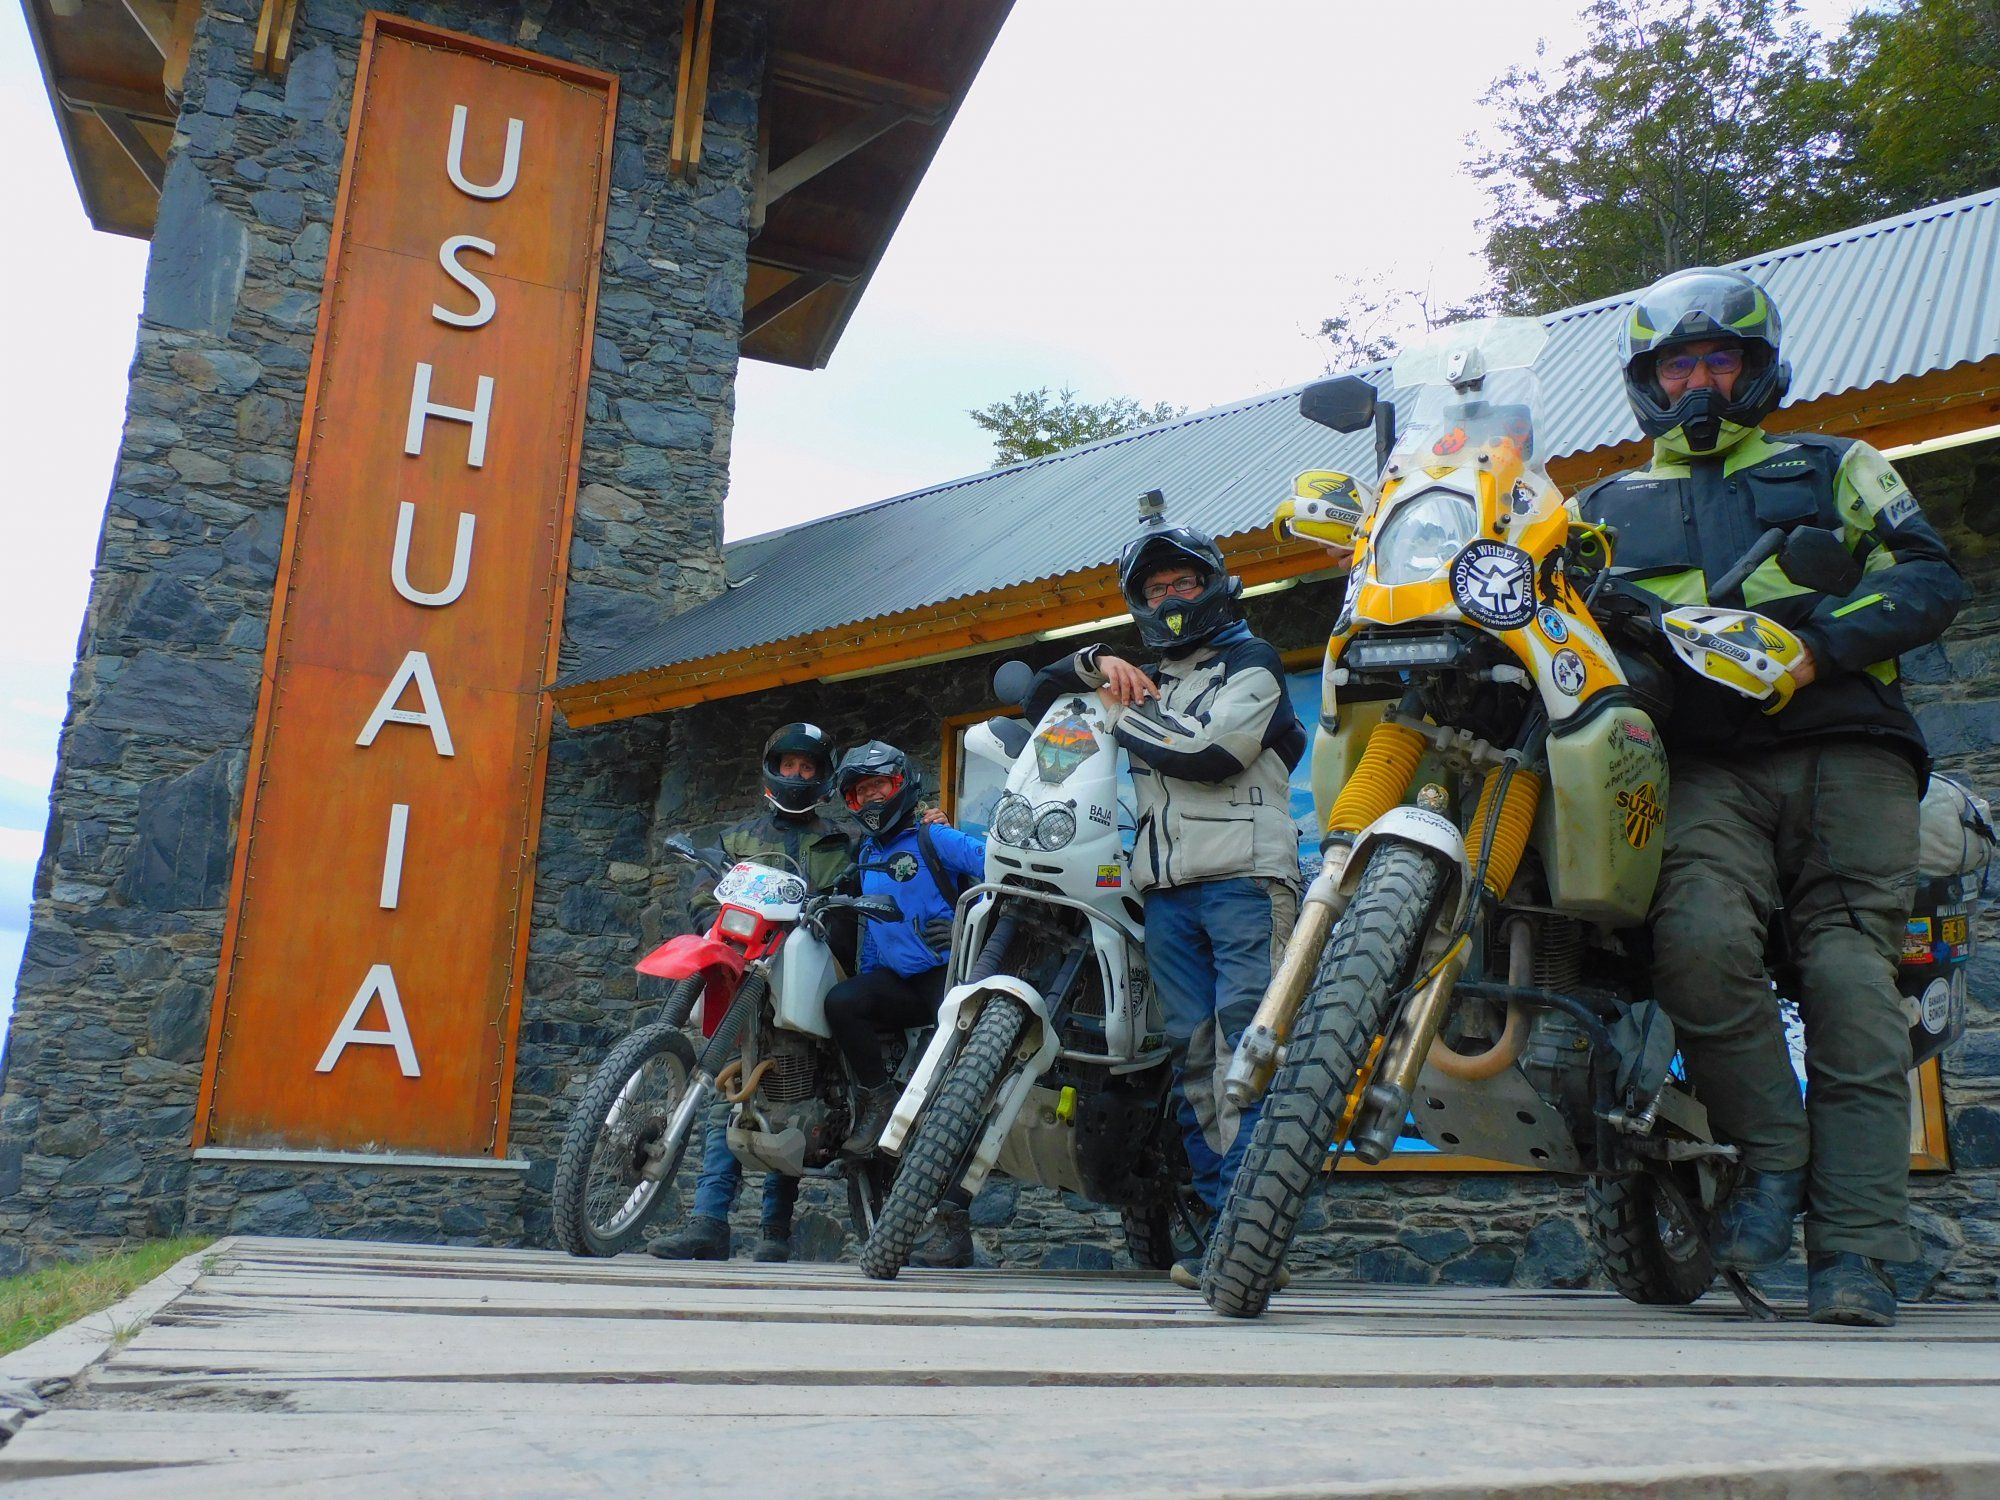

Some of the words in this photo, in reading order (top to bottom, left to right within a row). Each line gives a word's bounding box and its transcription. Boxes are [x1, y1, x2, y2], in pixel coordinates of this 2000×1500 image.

[315, 104, 523, 1079] USHUAIA
[1455, 550, 1477, 605] WOODY'S
[1477, 544, 1520, 562] WHEEL
[1521, 560, 1532, 607] WORKS
[1709, 638, 1748, 660] CYCRA
[1090, 804, 1112, 822] BAJA
[1615, 790, 1665, 826] SUZUKI
